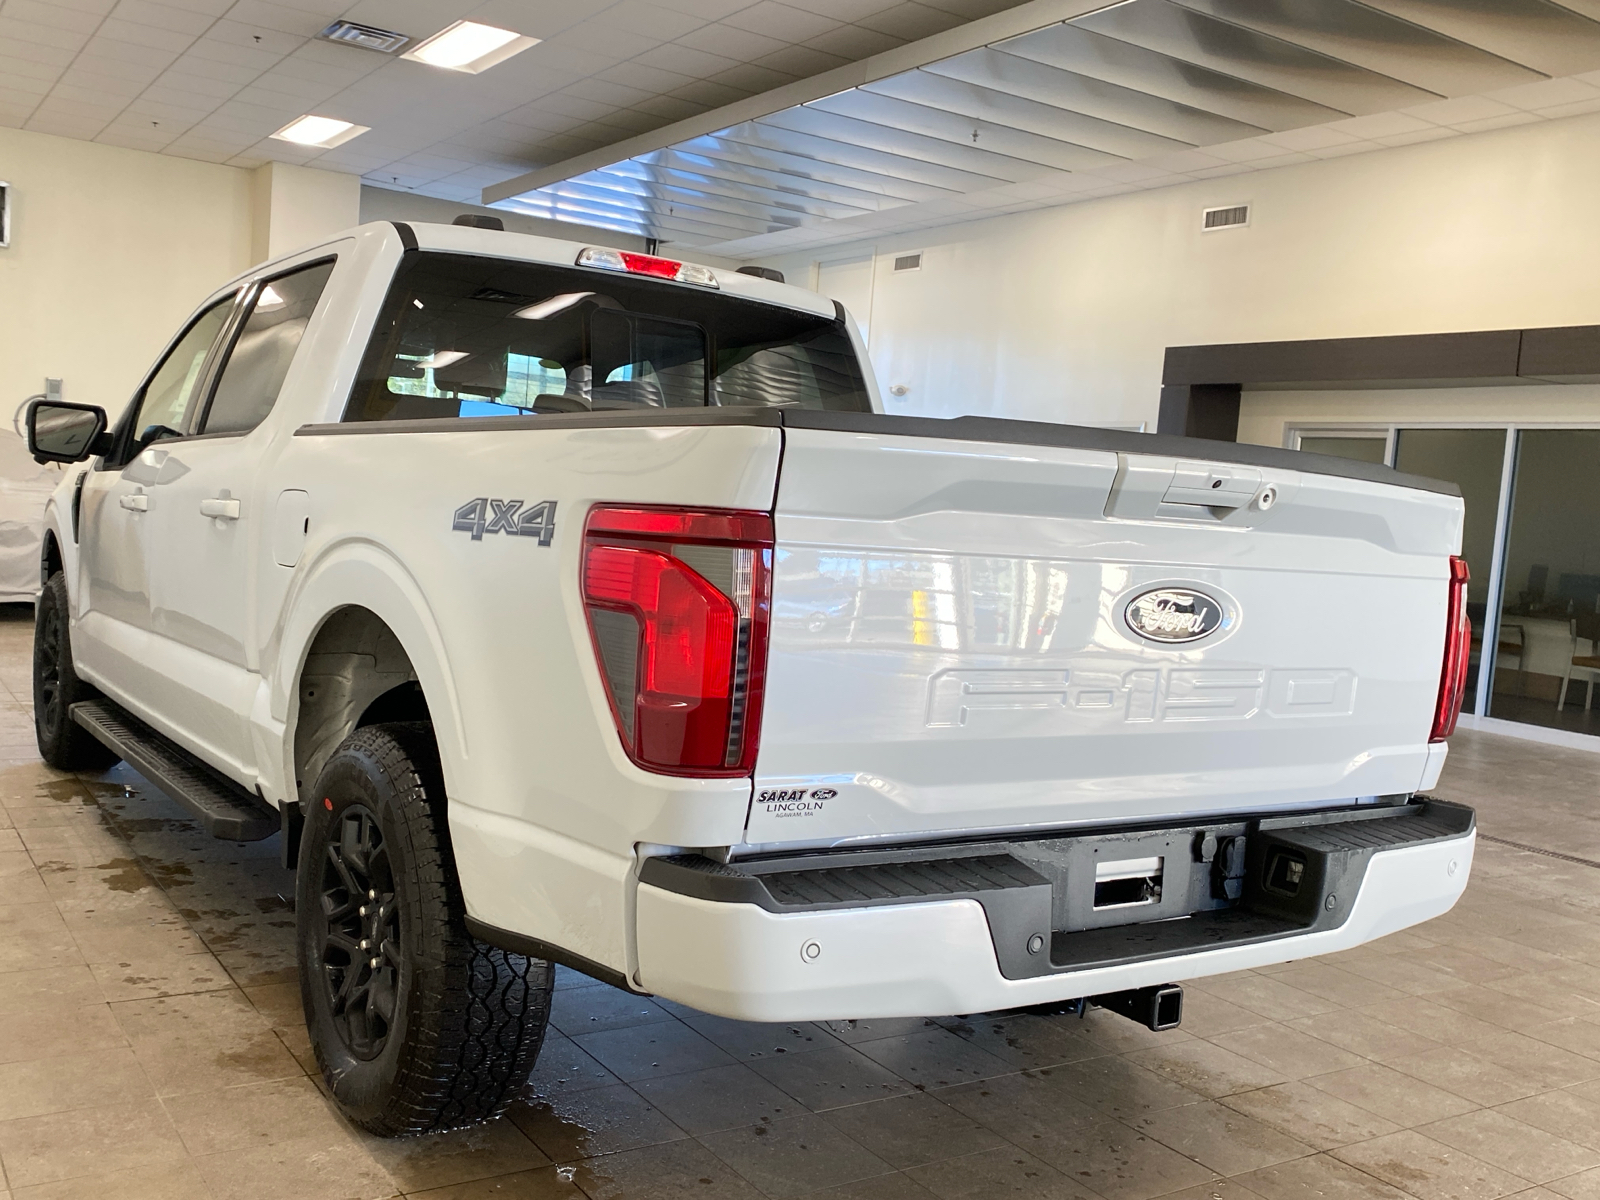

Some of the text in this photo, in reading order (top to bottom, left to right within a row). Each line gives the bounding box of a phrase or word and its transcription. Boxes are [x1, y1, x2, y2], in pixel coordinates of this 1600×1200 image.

[452, 497, 558, 548] 4X4
[1143, 593, 1208, 633] Ford
[924, 667, 1358, 728] F-150
[756, 789, 809, 803] SARAT
[766, 802, 824, 812] LINCOLN
